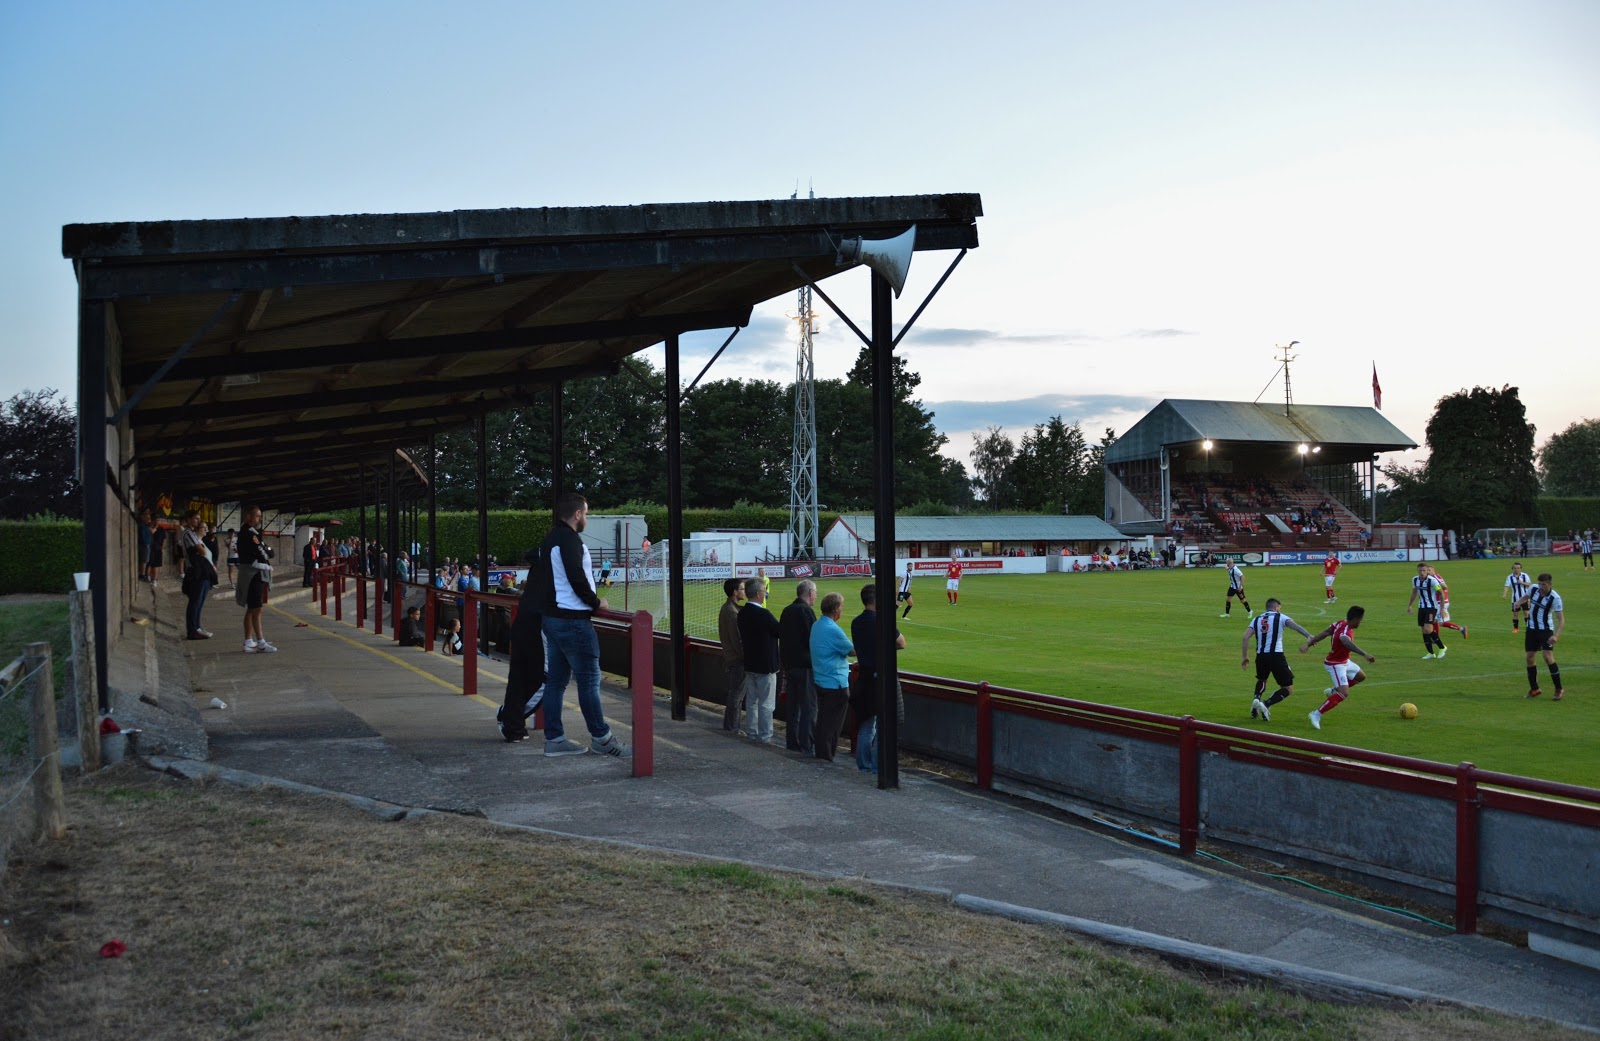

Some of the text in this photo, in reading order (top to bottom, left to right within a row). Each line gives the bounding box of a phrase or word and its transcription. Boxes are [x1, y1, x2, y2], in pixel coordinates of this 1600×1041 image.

[821, 562, 872, 575] XTRA COLA
[1260, 618, 1270, 633] 5
